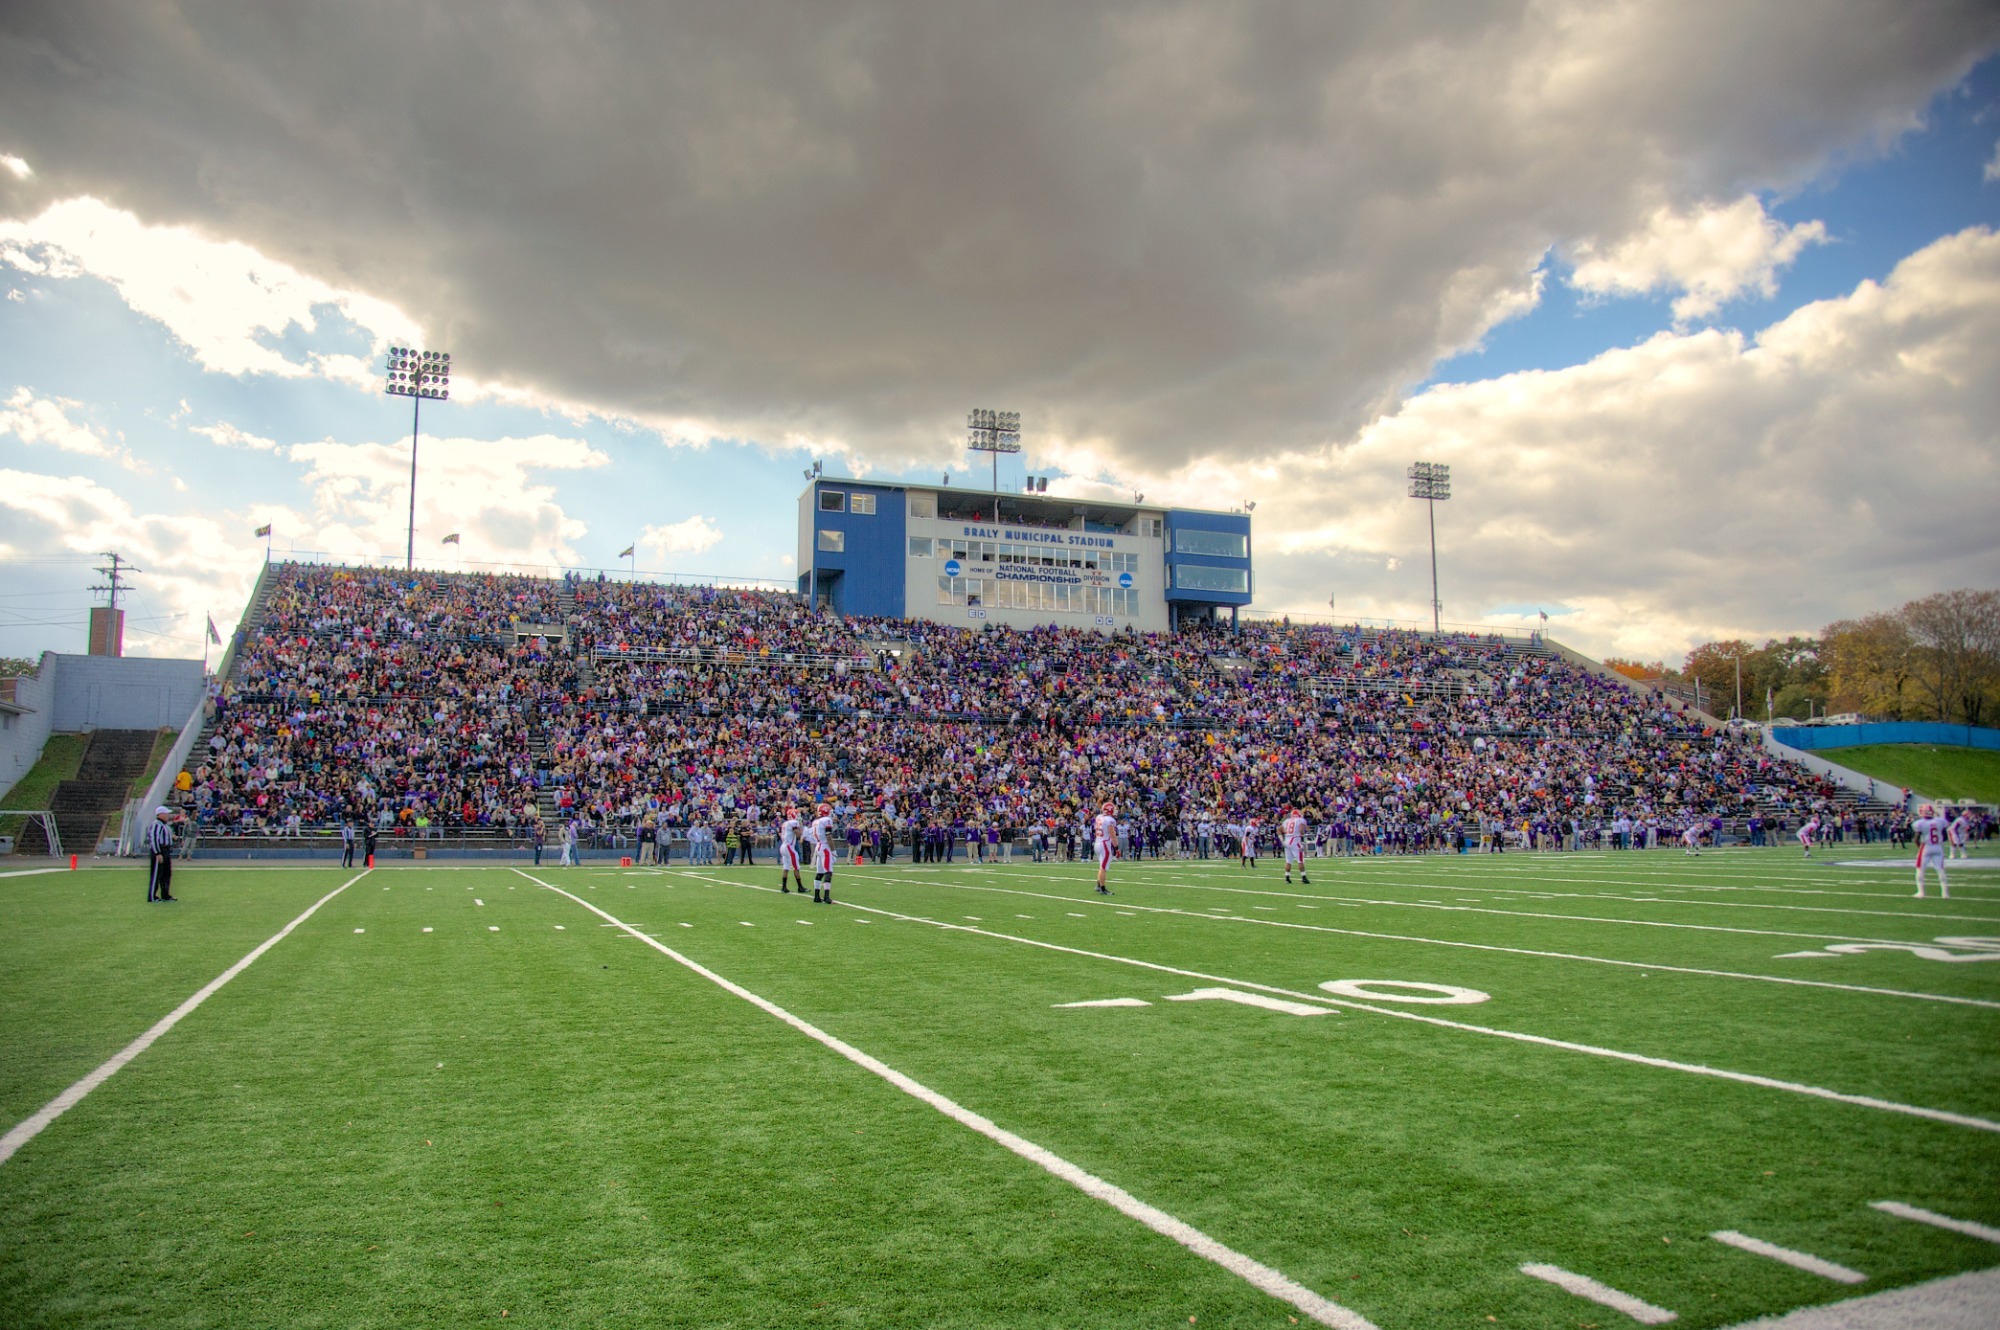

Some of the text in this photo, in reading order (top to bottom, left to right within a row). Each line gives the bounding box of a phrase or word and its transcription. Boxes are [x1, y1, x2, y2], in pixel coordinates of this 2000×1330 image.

[964, 527, 1114, 548] BRALY MUNICIPAL STADIUM
[999, 564, 1077, 576] NATIONAL FOOTBALL
[995, 572, 1081, 584] CHAMPIONSHIP
[1083, 574, 1110, 582] DIVISION
[1930, 827, 1939, 844] 6
[1162, 979, 1491, 1016] 10
